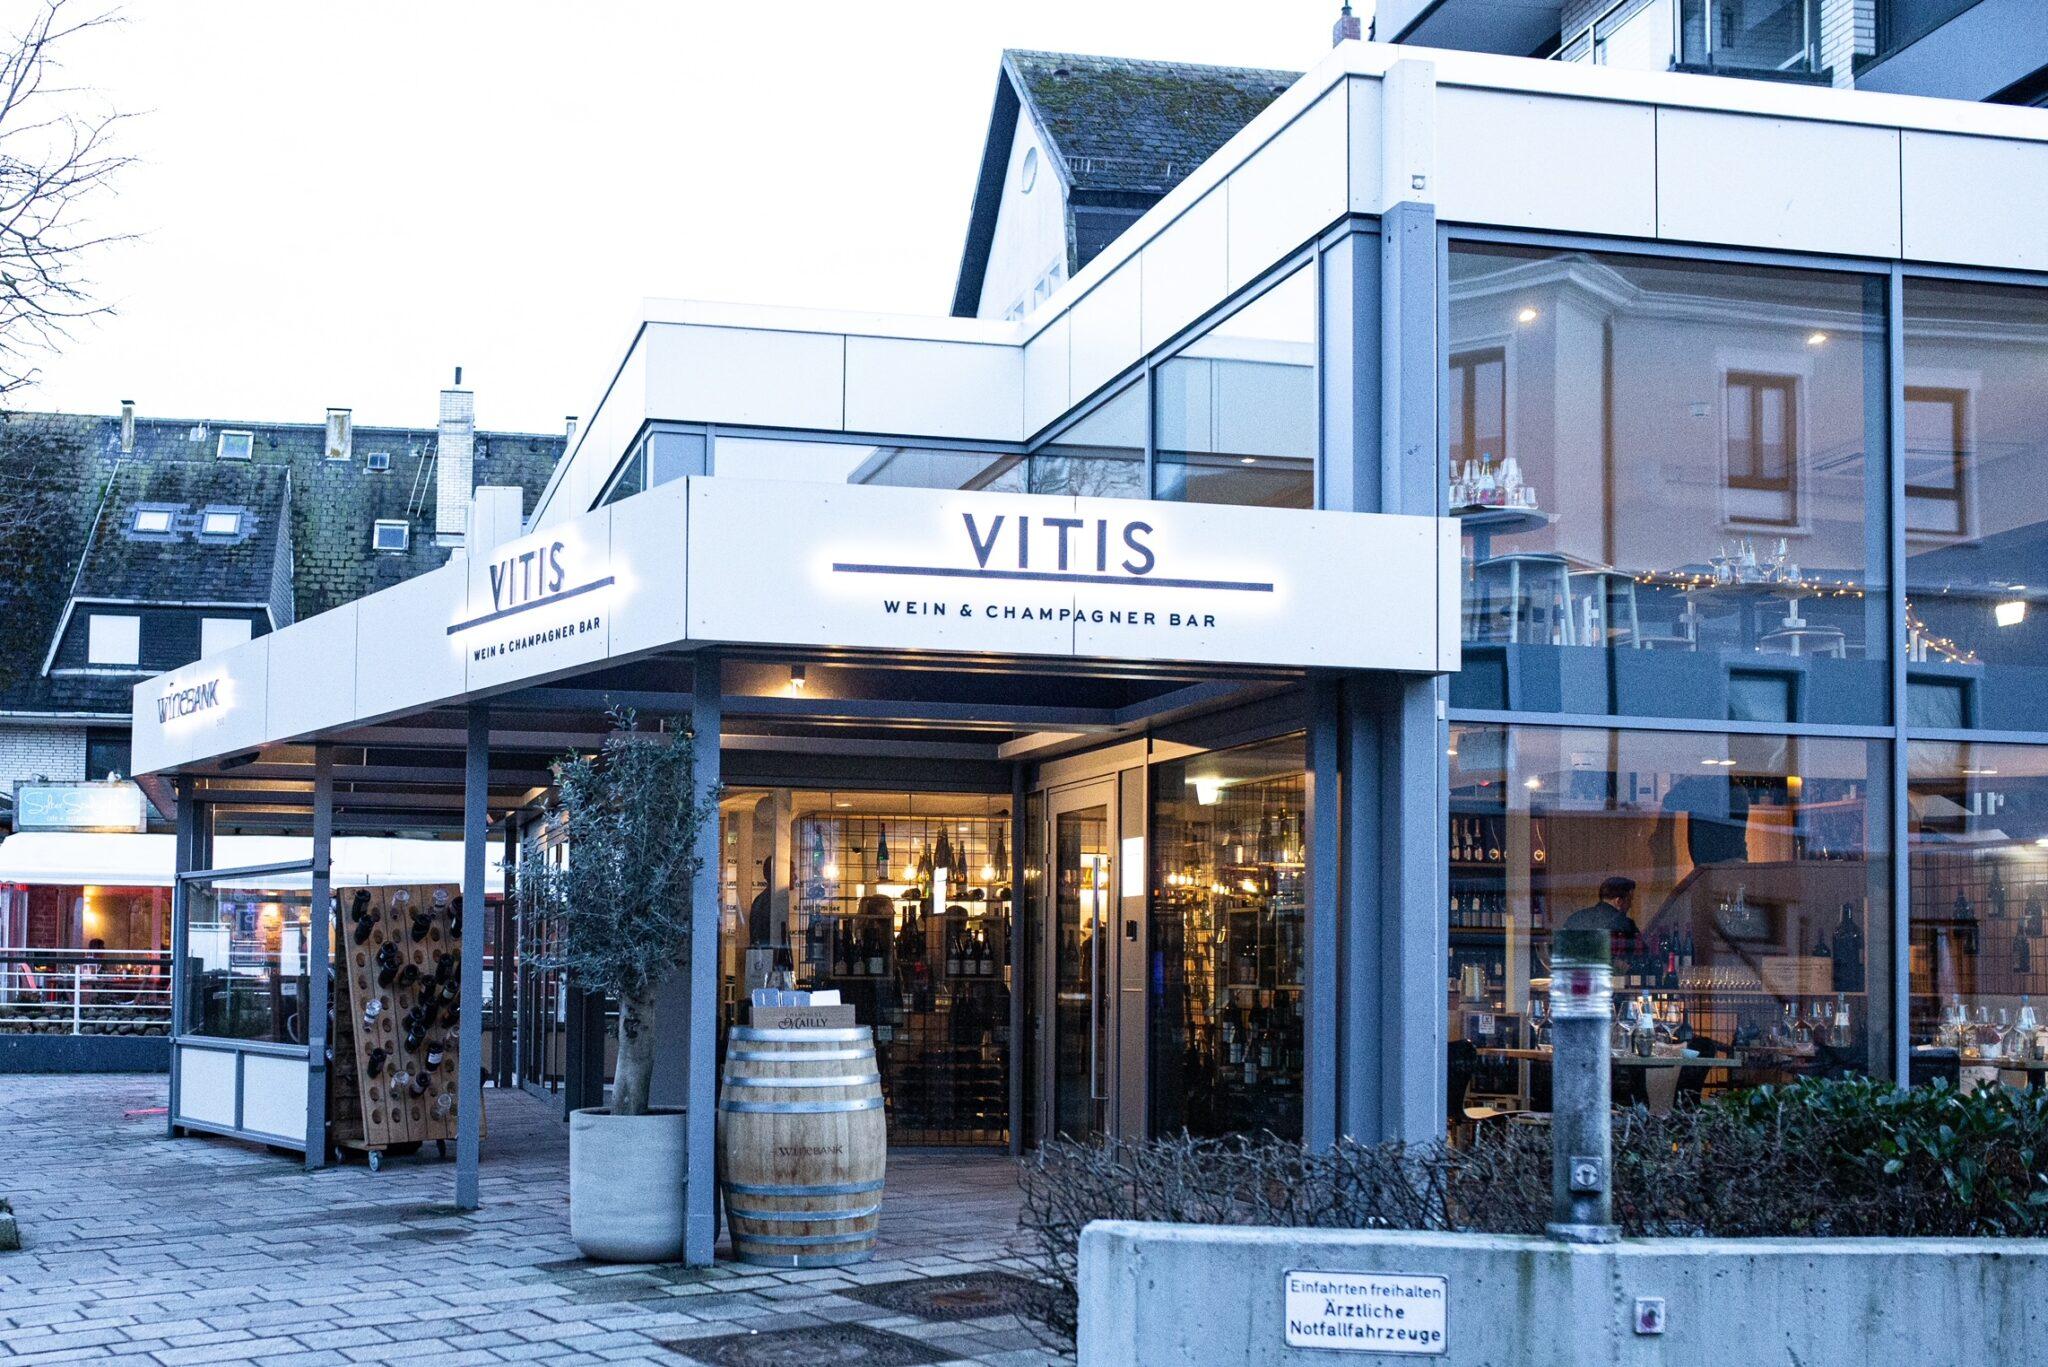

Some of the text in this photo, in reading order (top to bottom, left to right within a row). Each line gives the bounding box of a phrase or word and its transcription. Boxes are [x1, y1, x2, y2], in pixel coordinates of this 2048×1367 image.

[962, 512, 1155, 576] VITIS
[489, 541, 565, 612] VITIS
[884, 600, 1216, 628] WEIN & CHAMPAGNER BAR
[473, 617, 601, 661] WEIN & CHAMPAGNER BAR
[1291, 1280, 1441, 1299] Einfahrten freihalten
[1324, 1299, 1405, 1319] Ärztliche
[1291, 1320, 1441, 1345] Notfallfahrzeuge
